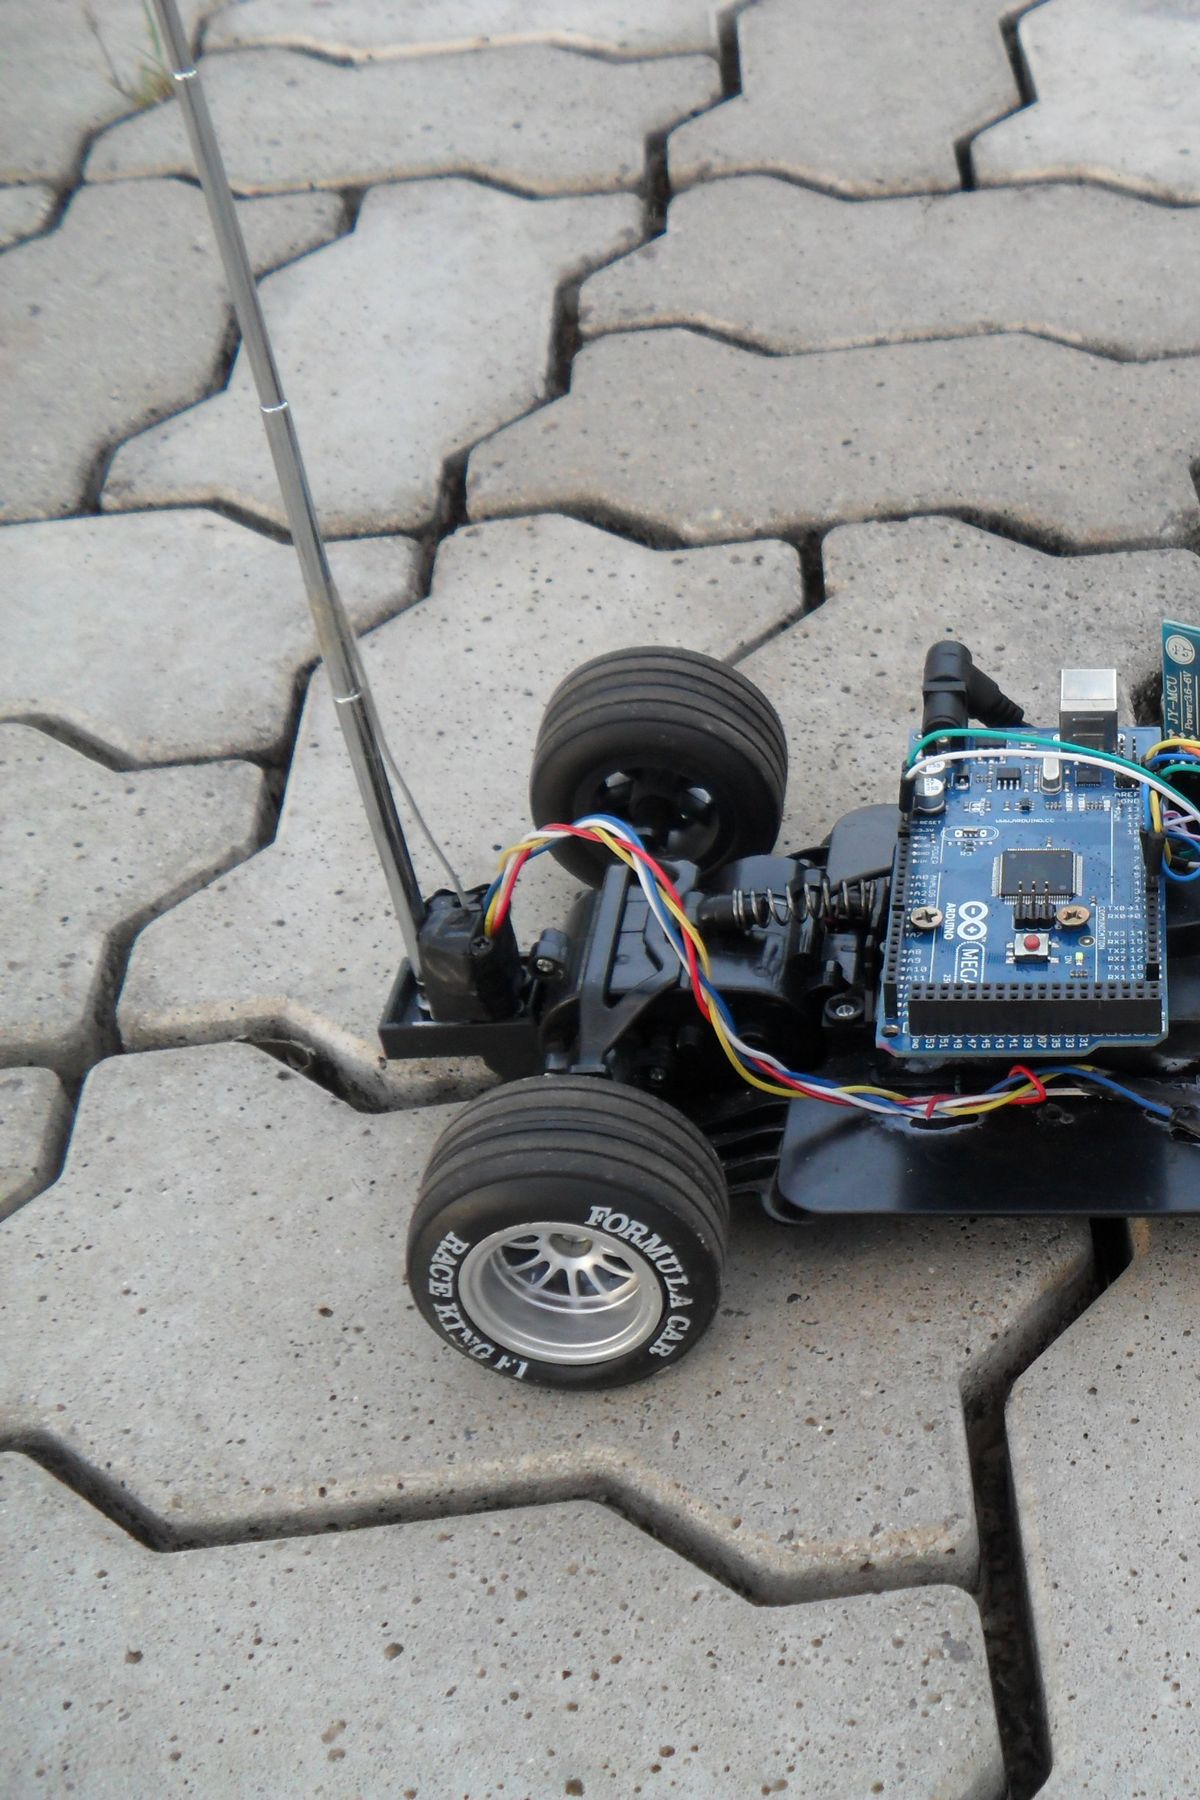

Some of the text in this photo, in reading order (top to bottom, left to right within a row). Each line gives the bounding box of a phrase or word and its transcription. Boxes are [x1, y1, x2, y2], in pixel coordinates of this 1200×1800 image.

[1166, 675, 1179, 725] JY-MCU
[943, 902, 956, 940] ARDUINO
[427, 1230, 470, 1298] RACE
[584, 1205, 694, 1358] FORMULA CAR
